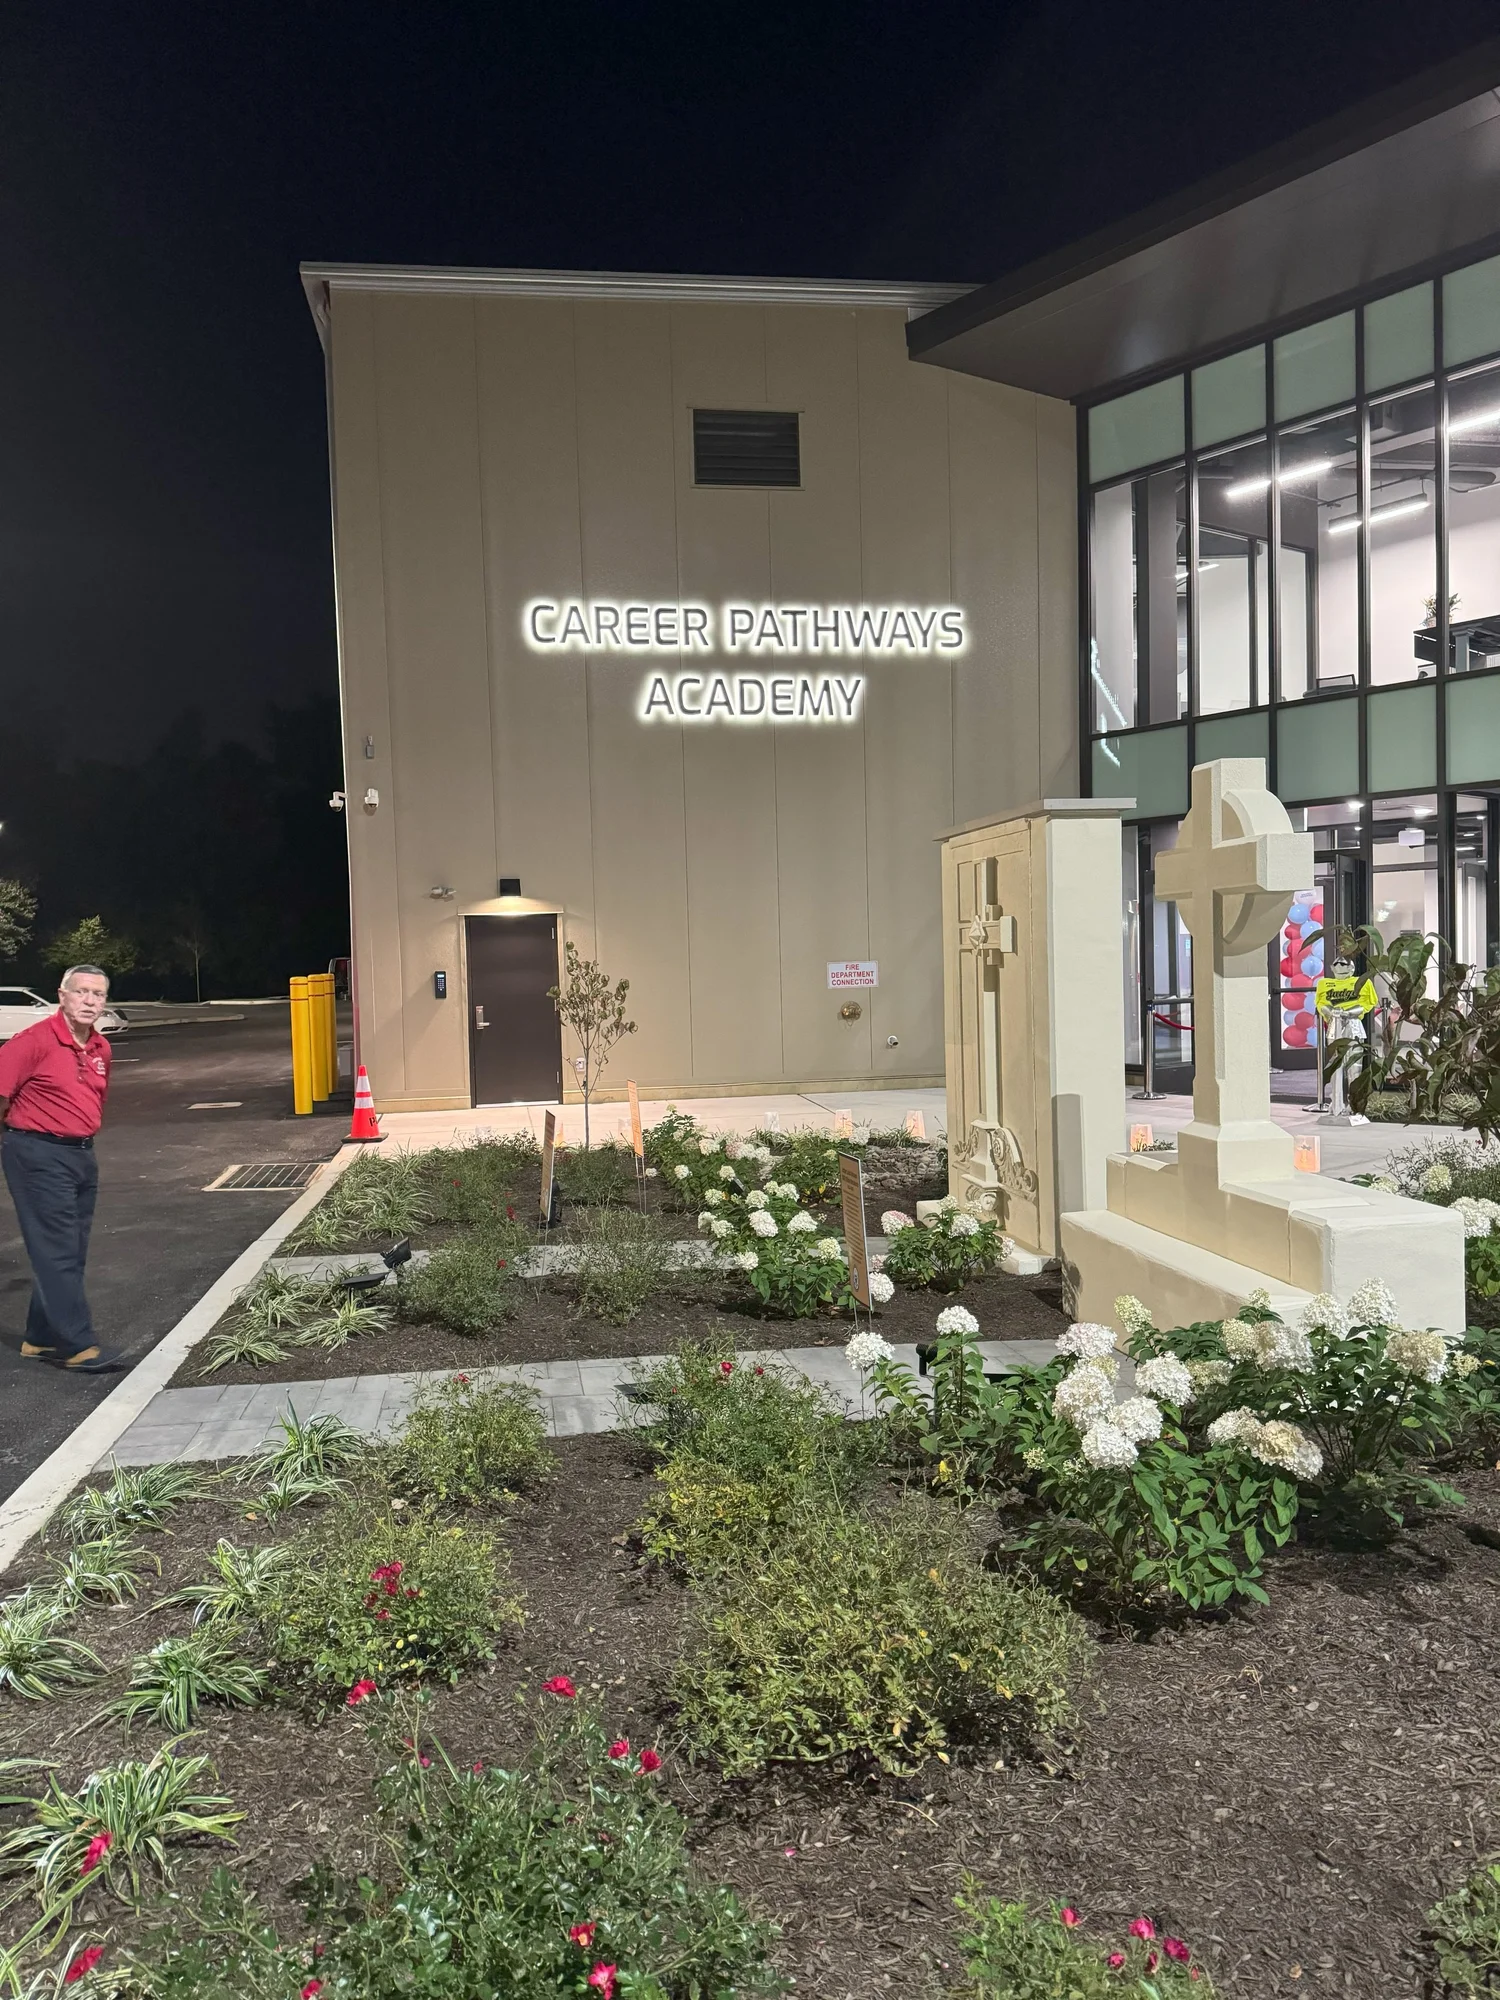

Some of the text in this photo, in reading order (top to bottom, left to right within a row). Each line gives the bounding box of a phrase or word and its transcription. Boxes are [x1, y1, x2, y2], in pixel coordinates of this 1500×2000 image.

[530, 604, 964, 649] CAREER PATHWAYS
[644, 677, 862, 717] ACADEMY
[845, 963, 860, 971] FIRE
[831, 971, 875, 979] DEPARTMENT
[831, 978, 875, 986] CONNECTION
